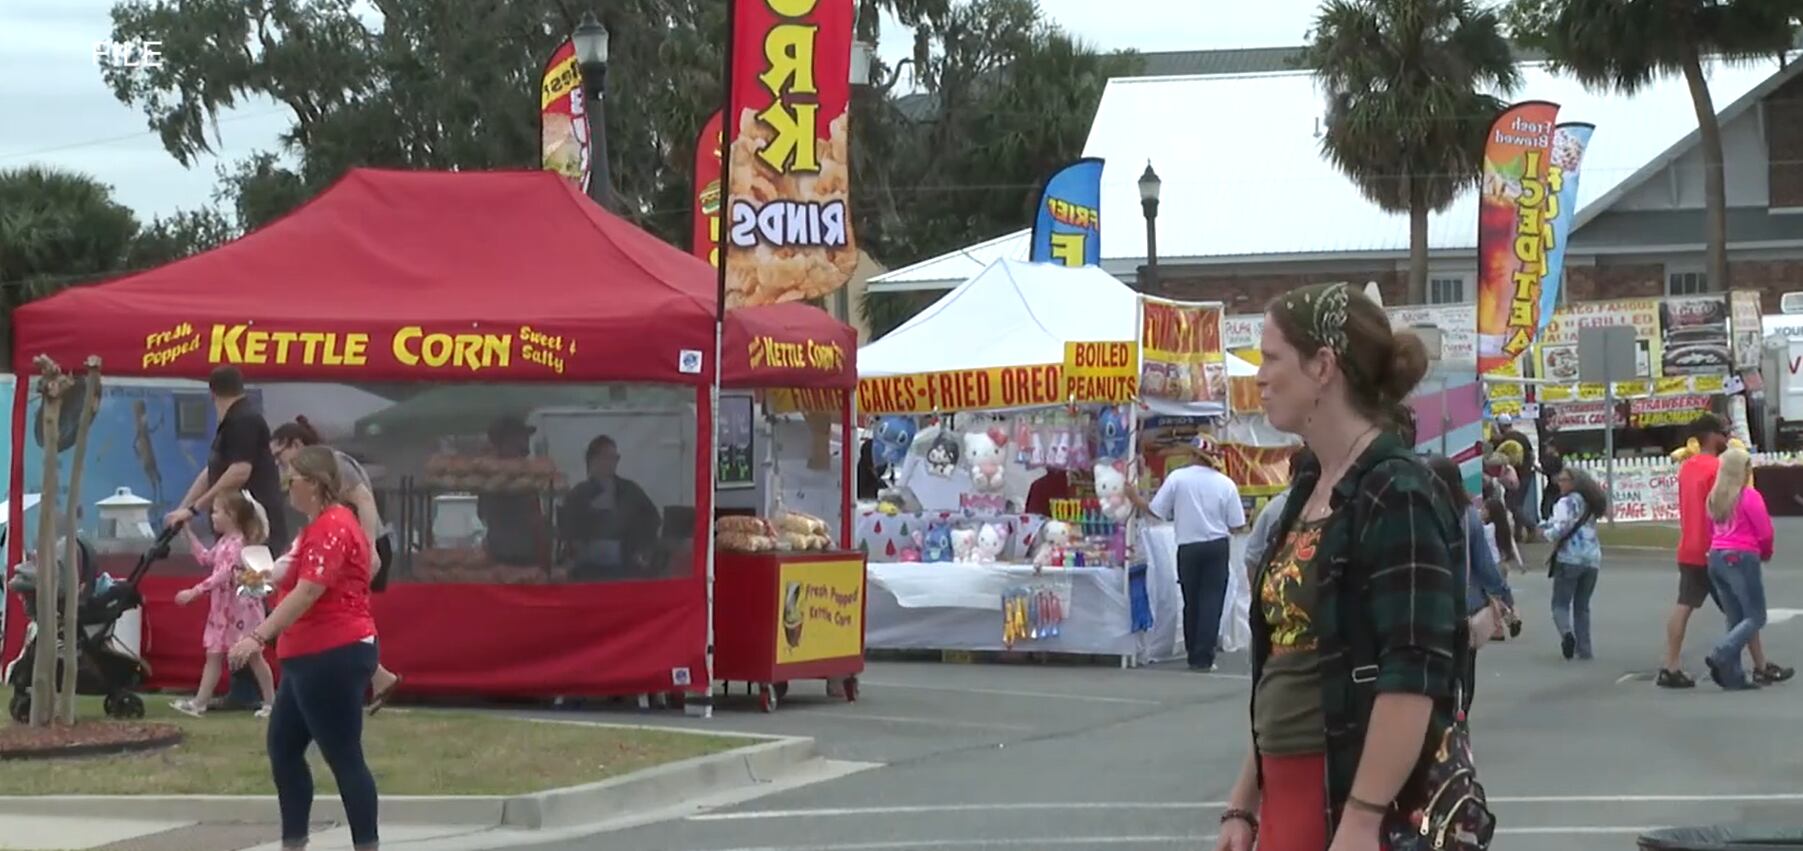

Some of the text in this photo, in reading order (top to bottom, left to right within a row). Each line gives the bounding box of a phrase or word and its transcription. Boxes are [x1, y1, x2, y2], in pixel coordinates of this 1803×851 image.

[146, 323, 193, 351] Fresh
[209, 324, 512, 370] KETTLE CORN
[520, 327, 562, 352] Sweet
[142, 335, 202, 369] Popped
[522, 346, 564, 373] Salty
[1074, 342, 1129, 368] BOILED
[858, 376, 917, 413] CAKES
[927, 370, 990, 408] FRIED
[1066, 376, 1137, 402] PEANUTS
